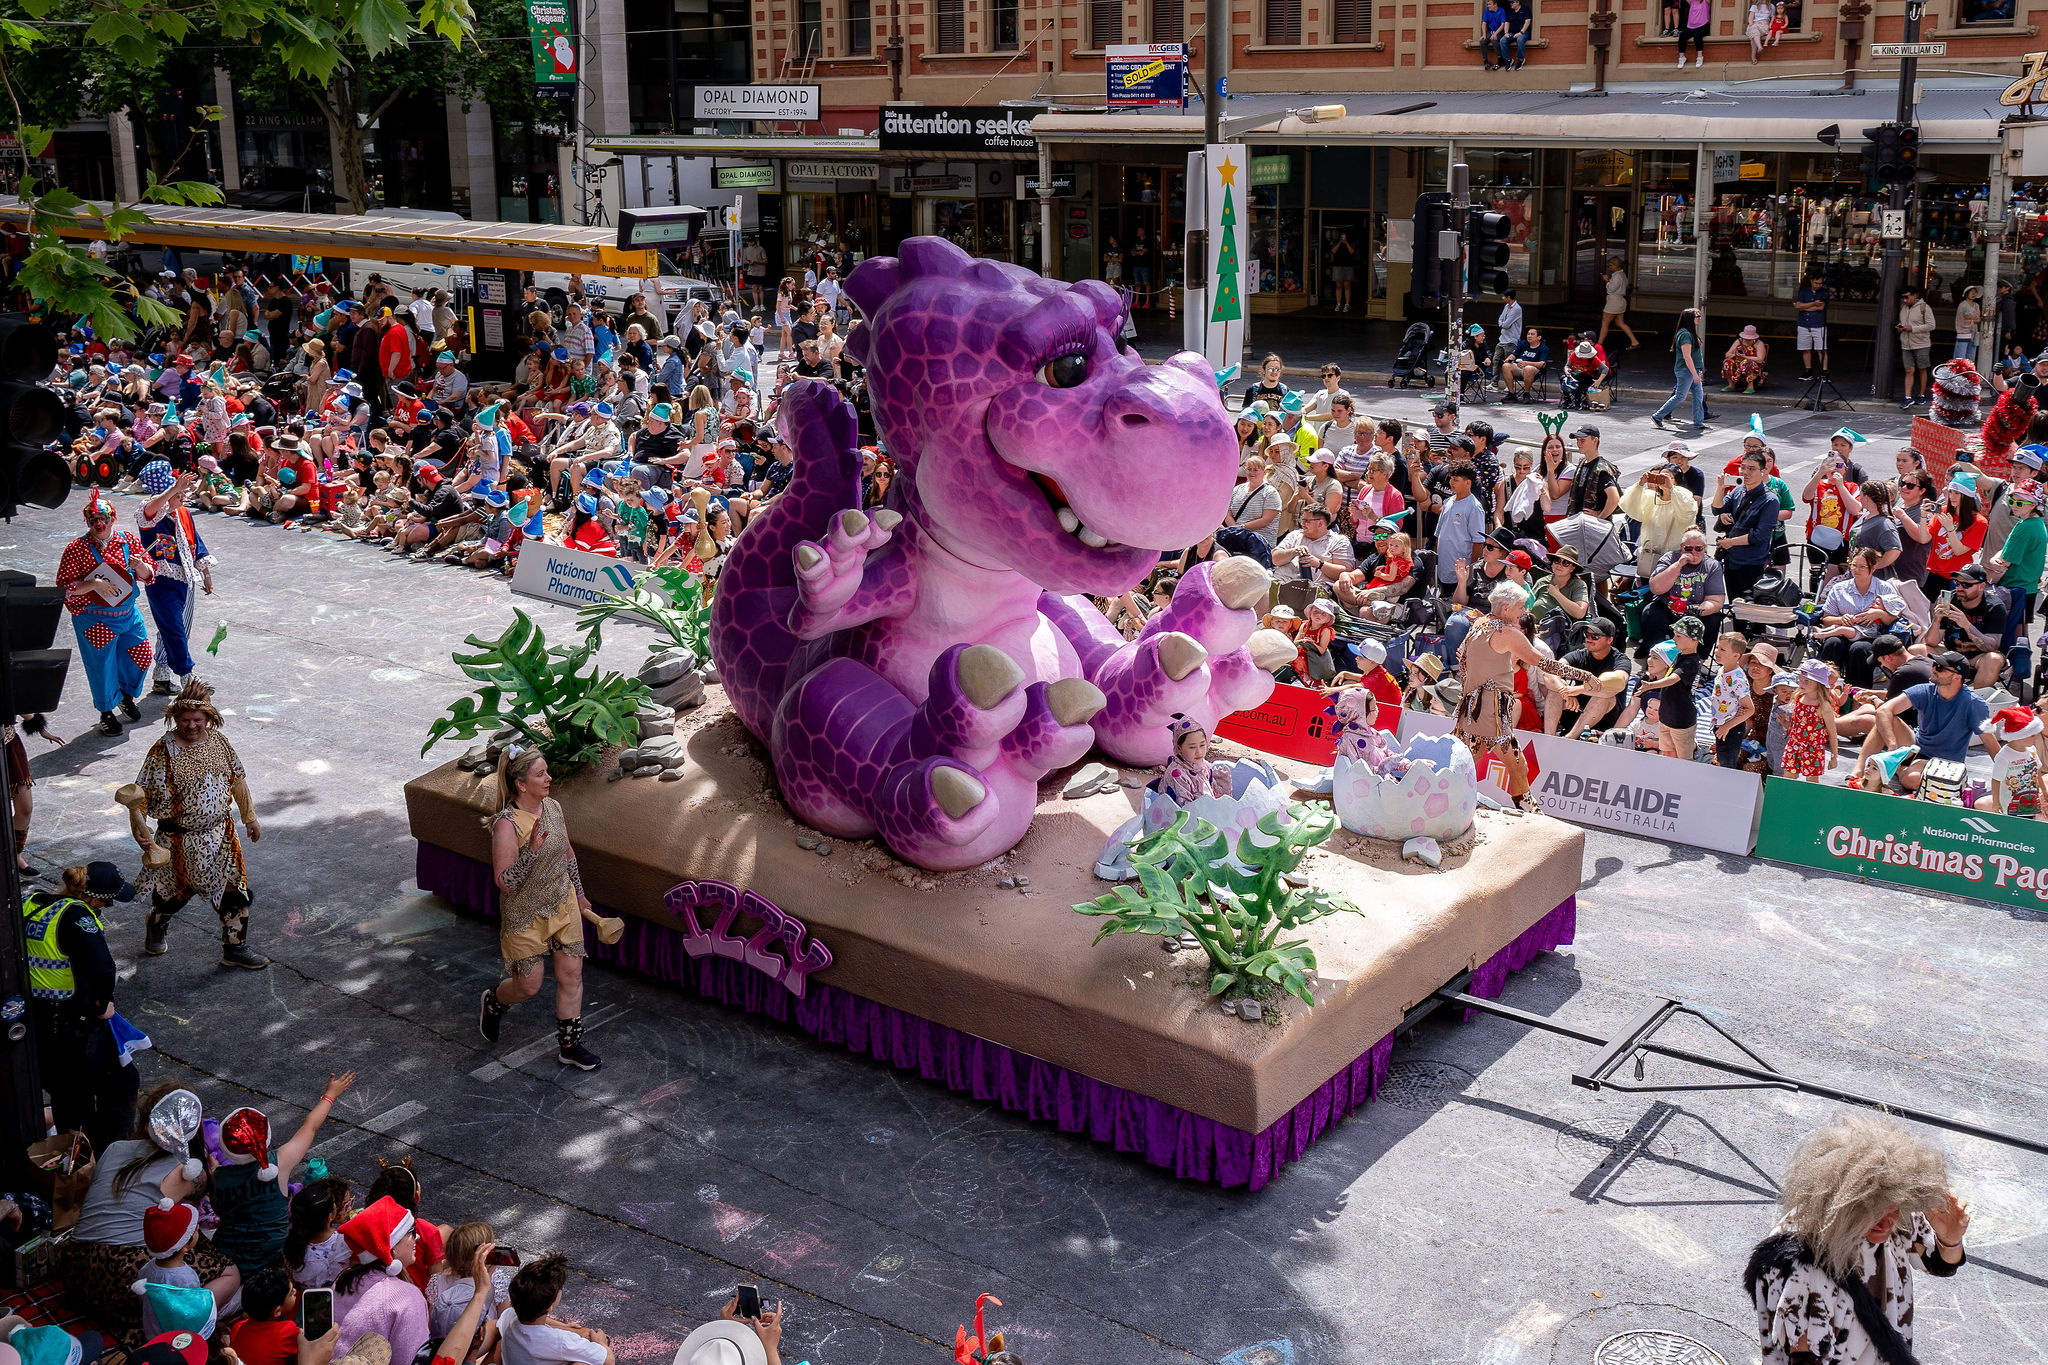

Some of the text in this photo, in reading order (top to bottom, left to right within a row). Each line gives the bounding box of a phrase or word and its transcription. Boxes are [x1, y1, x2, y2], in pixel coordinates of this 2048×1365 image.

[530, 5, 566, 15] Christmas
[534, 15, 565, 24] Pageant
[1882, 44, 1942, 54] KING WILLIAM ST
[1125, 68, 1149, 86] SOLD
[703, 90, 809, 104] OPAL DIAMOND
[245, 115, 323, 125] 22 KING WILLIAM
[884, 111, 971, 134] attention
[985, 136, 1034, 147] coffee house
[1583, 157, 1625, 165] HAIGH'S
[719, 170, 772, 179] OPAL DIAMOND
[791, 164, 876, 177] OPAL FACTORY
[602, 264, 643, 275] Rundle Mall
[546, 557, 598, 583] National
[1541, 770, 1682, 819] ADELAIDE
[1538, 795, 1677, 833] SOUTH AUSTRALIA
[1922, 825, 2036, 854] National Pharmacies
[1826, 825, 1985, 883] Christmas
[663, 880, 833, 1000] IZZY
